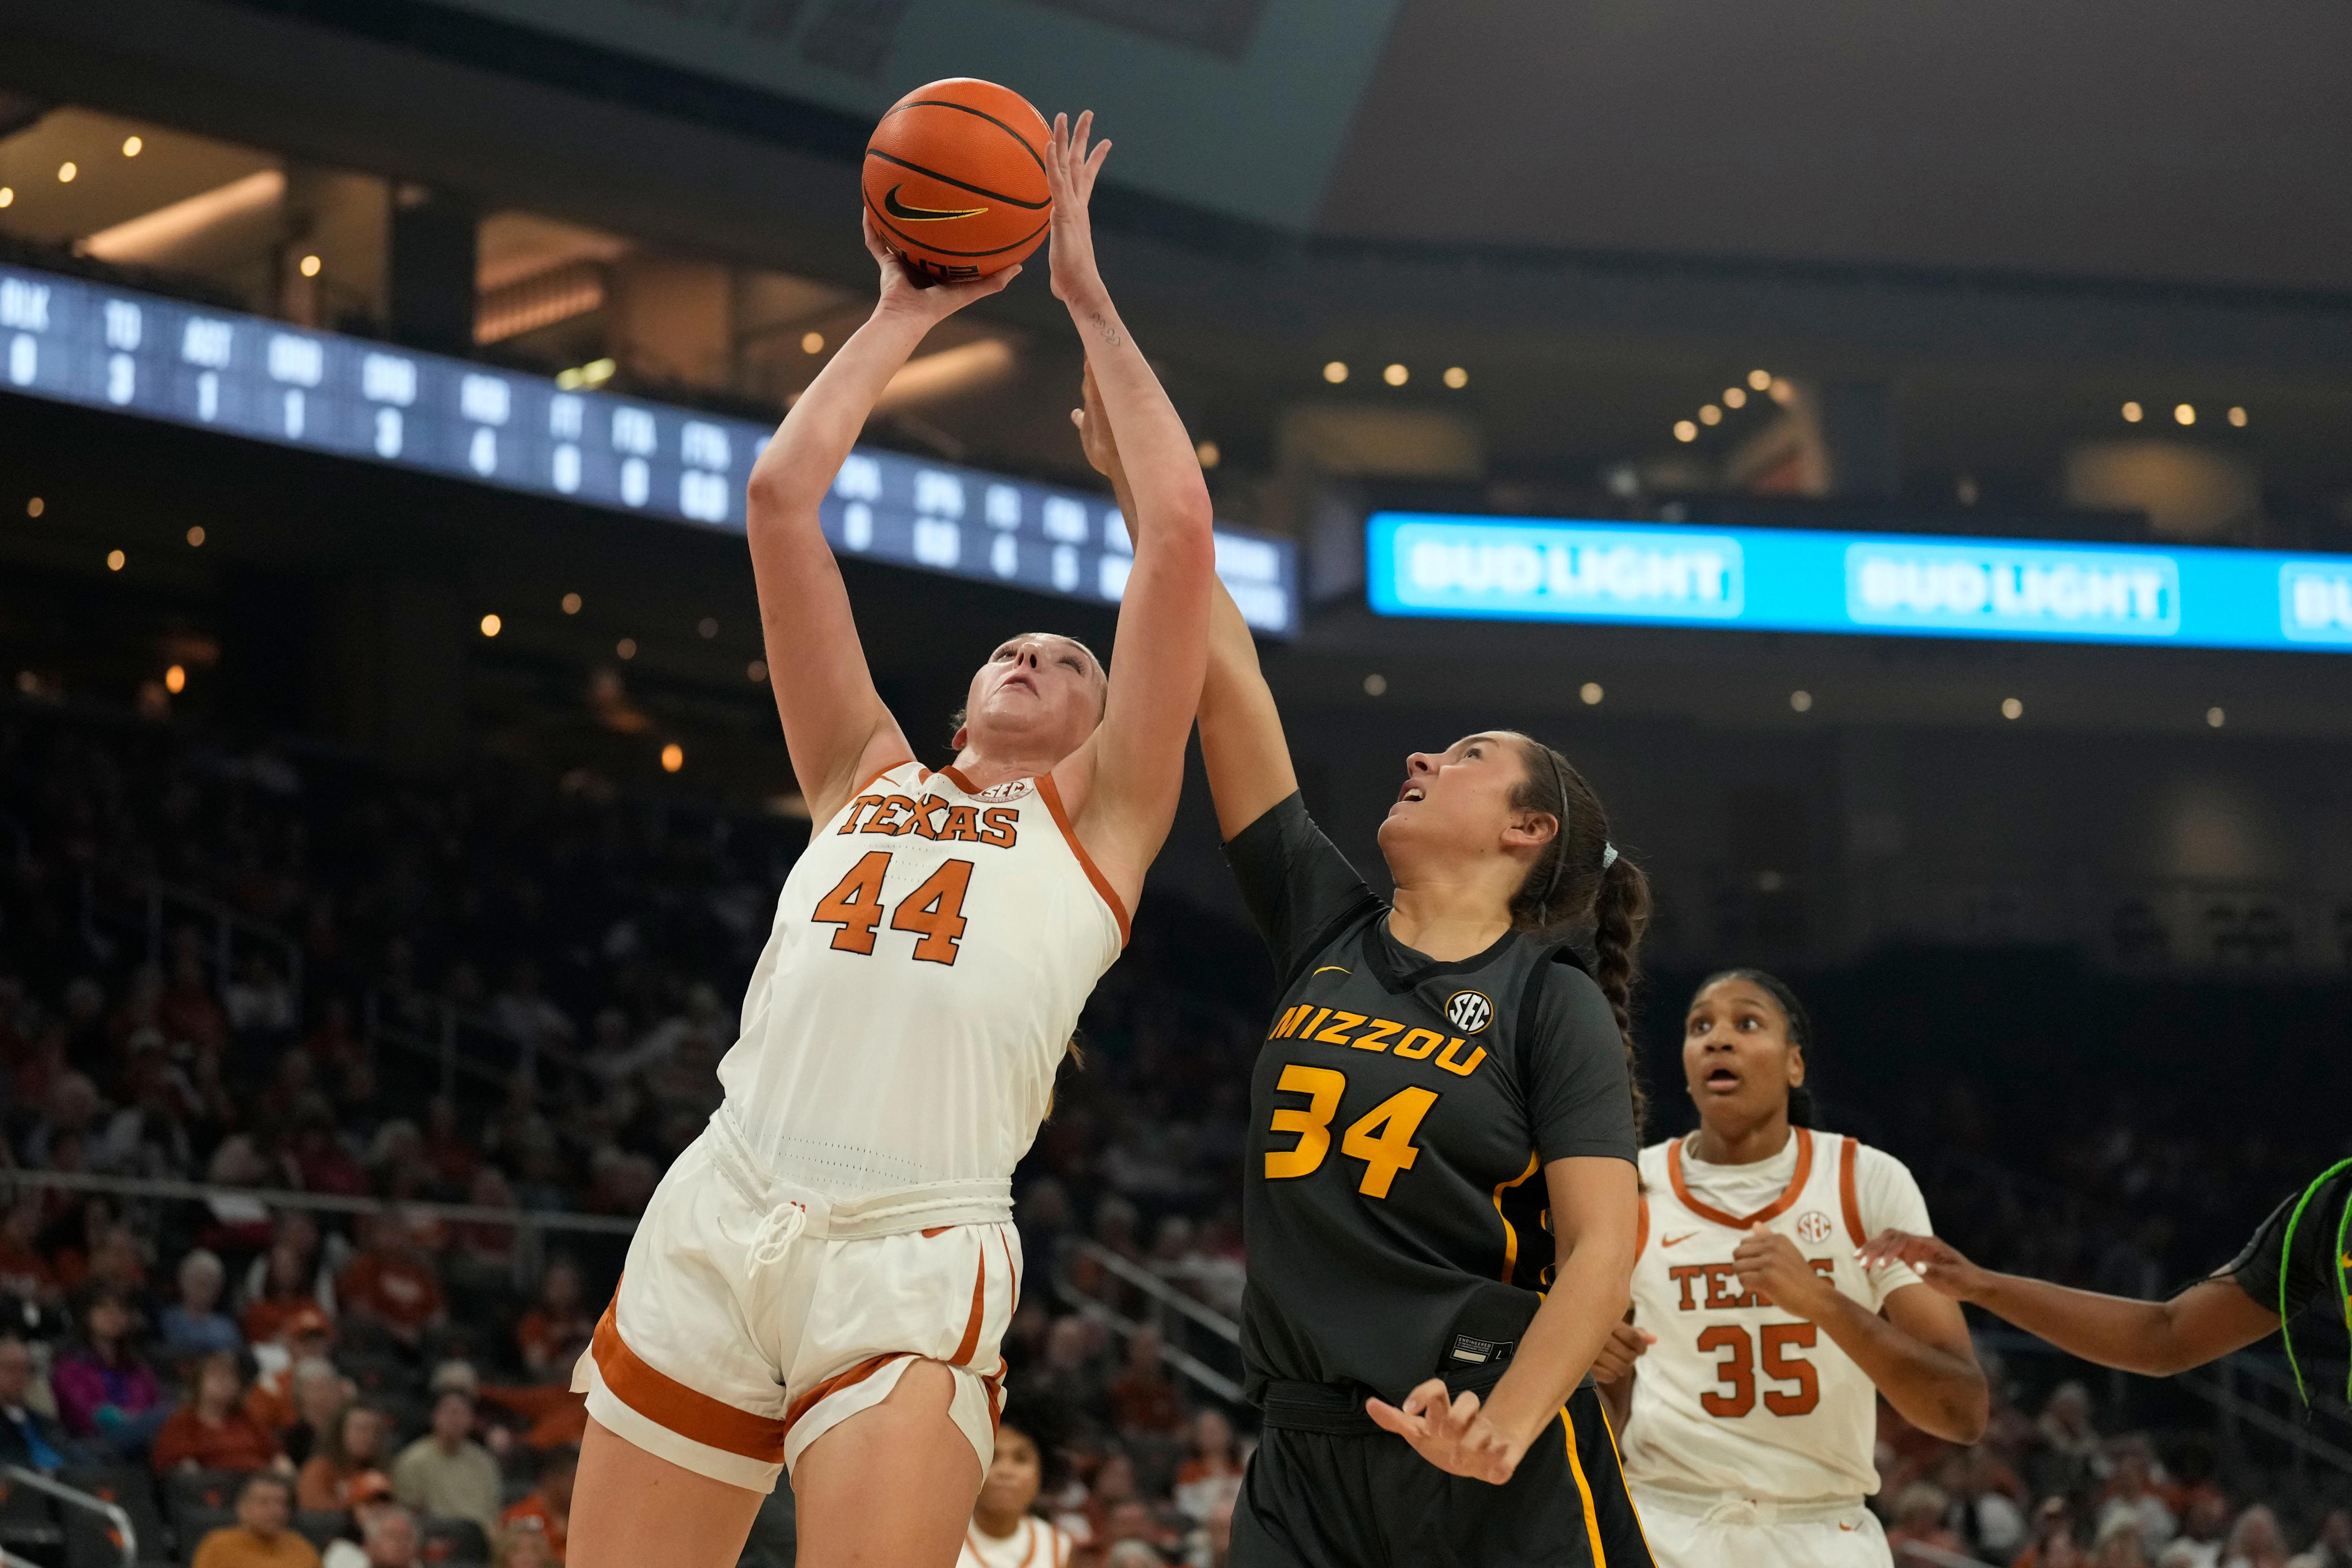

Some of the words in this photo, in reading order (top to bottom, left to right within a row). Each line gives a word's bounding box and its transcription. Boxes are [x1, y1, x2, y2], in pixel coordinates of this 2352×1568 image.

[1410, 540, 1541, 593] BUD
[1546, 545, 1722, 601] LIGHT
[1859, 558, 1987, 611] BUD
[1992, 565, 2160, 620] LIGHT
[981, 782, 1025, 798] SEC
[837, 793, 1019, 849] TEXAS
[811, 851, 975, 967] 44
[1268, 1004, 1487, 1076] MIZZOU
[1449, 993, 1490, 1033] SEC
[1264, 1064, 1439, 1199] 34
[1797, 1212, 1832, 1243] SEC
[1697, 1322, 1820, 1418] 35
